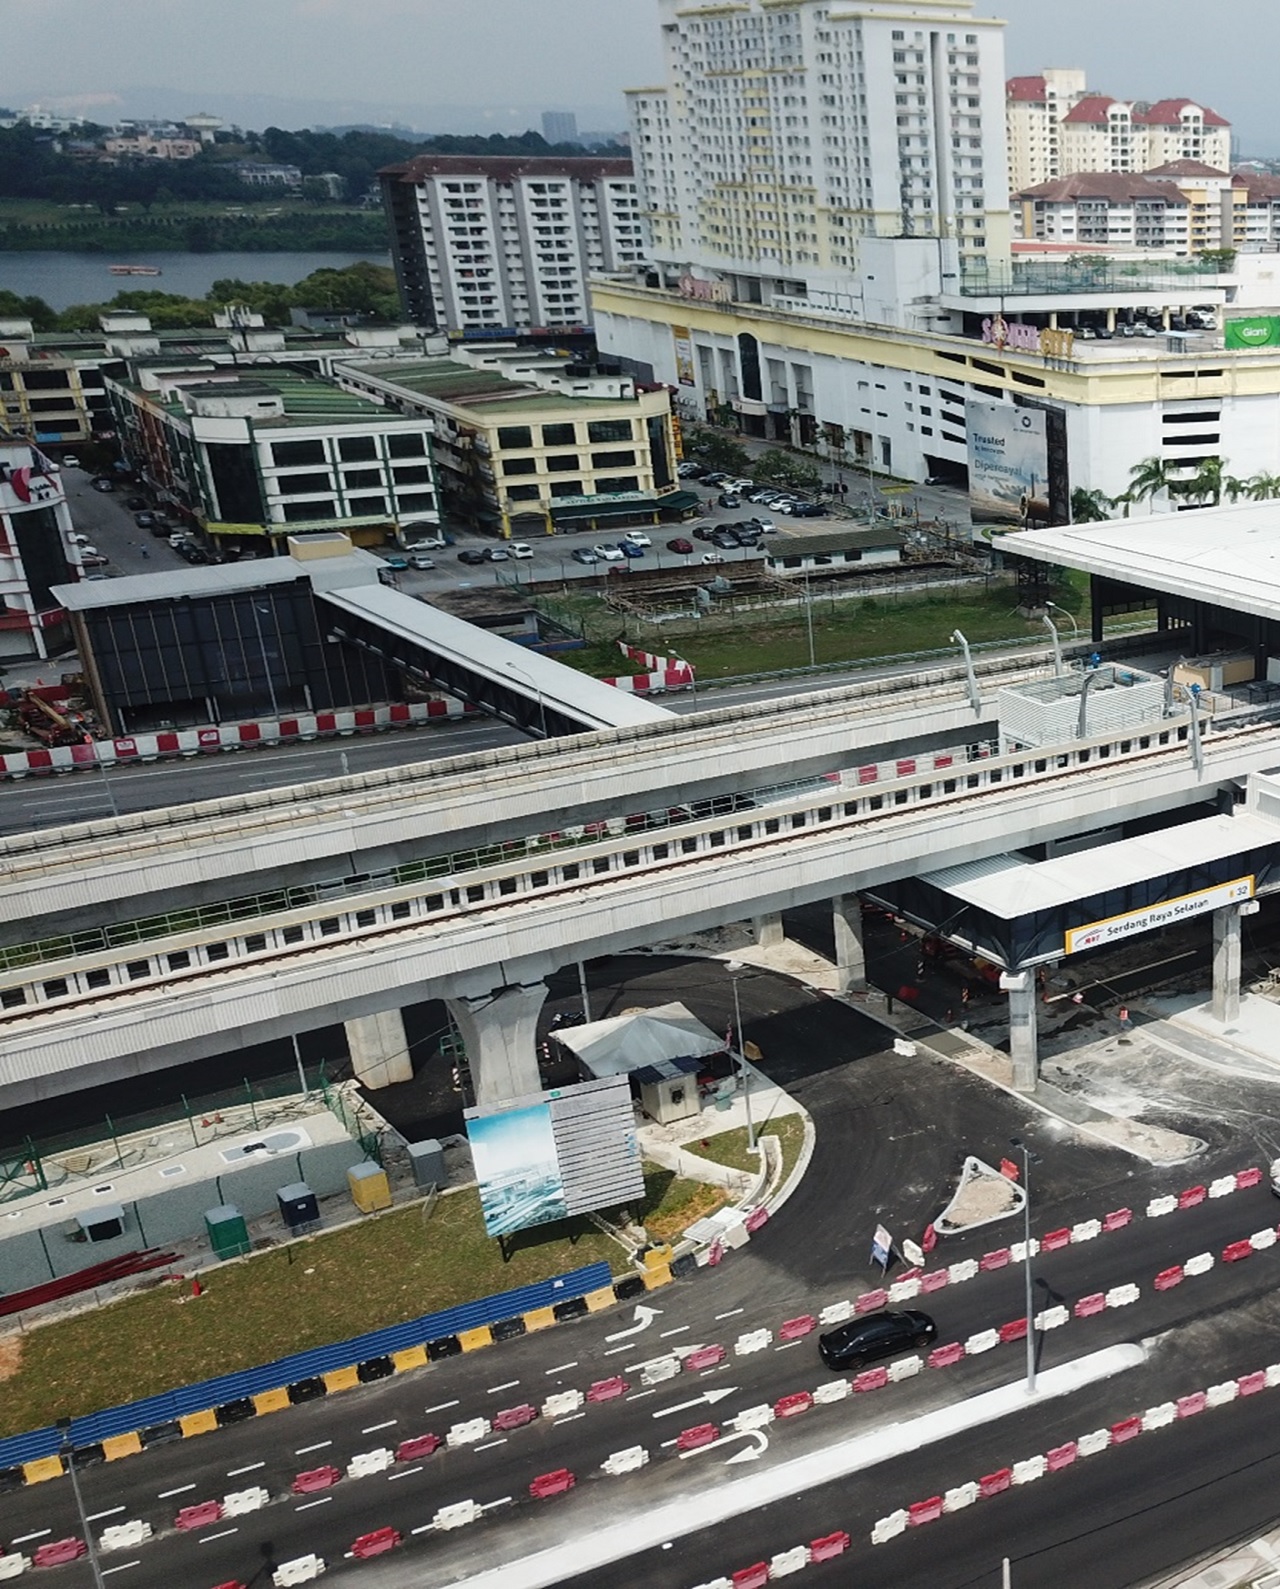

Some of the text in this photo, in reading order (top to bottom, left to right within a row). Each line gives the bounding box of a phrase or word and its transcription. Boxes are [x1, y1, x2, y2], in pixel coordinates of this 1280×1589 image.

[1242, 327, 1268, 337] Giant
[973, 433, 1006, 446] Trusted
[1107, 917, 1148, 936] Serdang
[1149, 910, 1173, 924] Raya
[1174, 899, 1209, 915] Selatan
